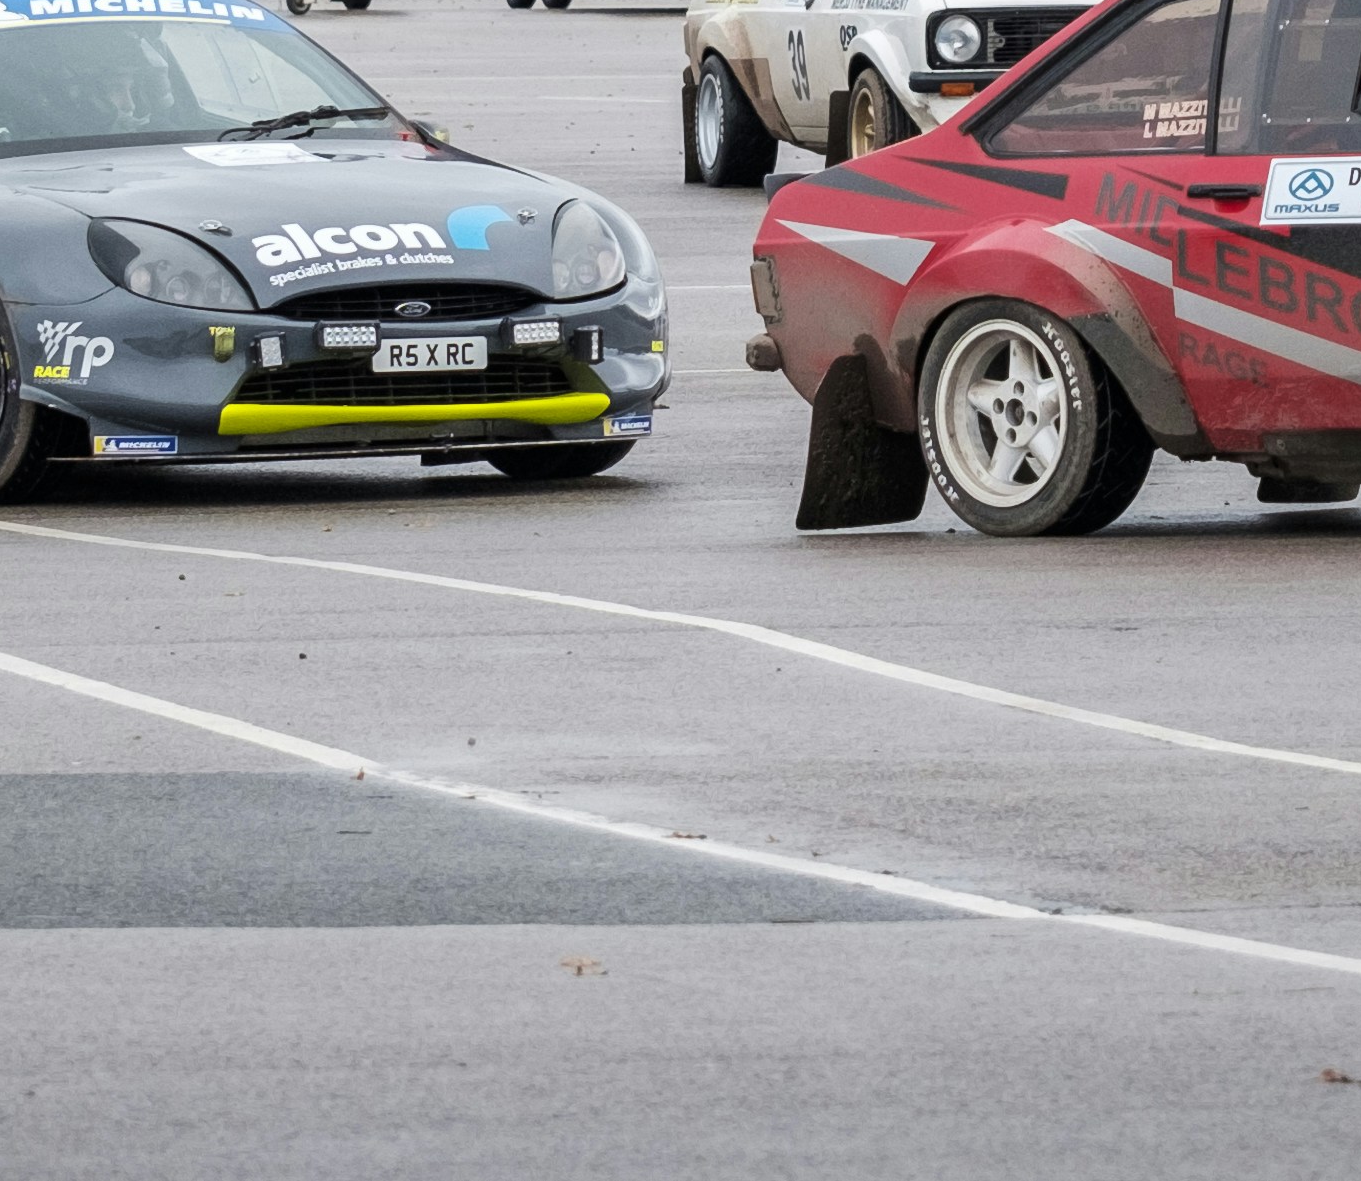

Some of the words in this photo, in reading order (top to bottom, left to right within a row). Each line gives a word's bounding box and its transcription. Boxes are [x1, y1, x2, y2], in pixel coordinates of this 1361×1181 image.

[788, 29, 810, 100] 39
[1143, 122, 1153, 138] L
[1274, 203, 1340, 214] MAXUS
[252, 223, 446, 266] alcon
[269, 261, 336, 287] specialist
[337, 256, 383, 271] brakes
[385, 253, 398, 265] &
[399, 252, 454, 264] clutches
[390, 344, 418, 366] R5
[426, 344, 439, 366] X
[446, 342, 474, 366] RC
[34, 365, 70, 378] RACE
[33, 378, 88, 386] PERFORMANCE
[119, 441, 171, 449] MICHELIN
